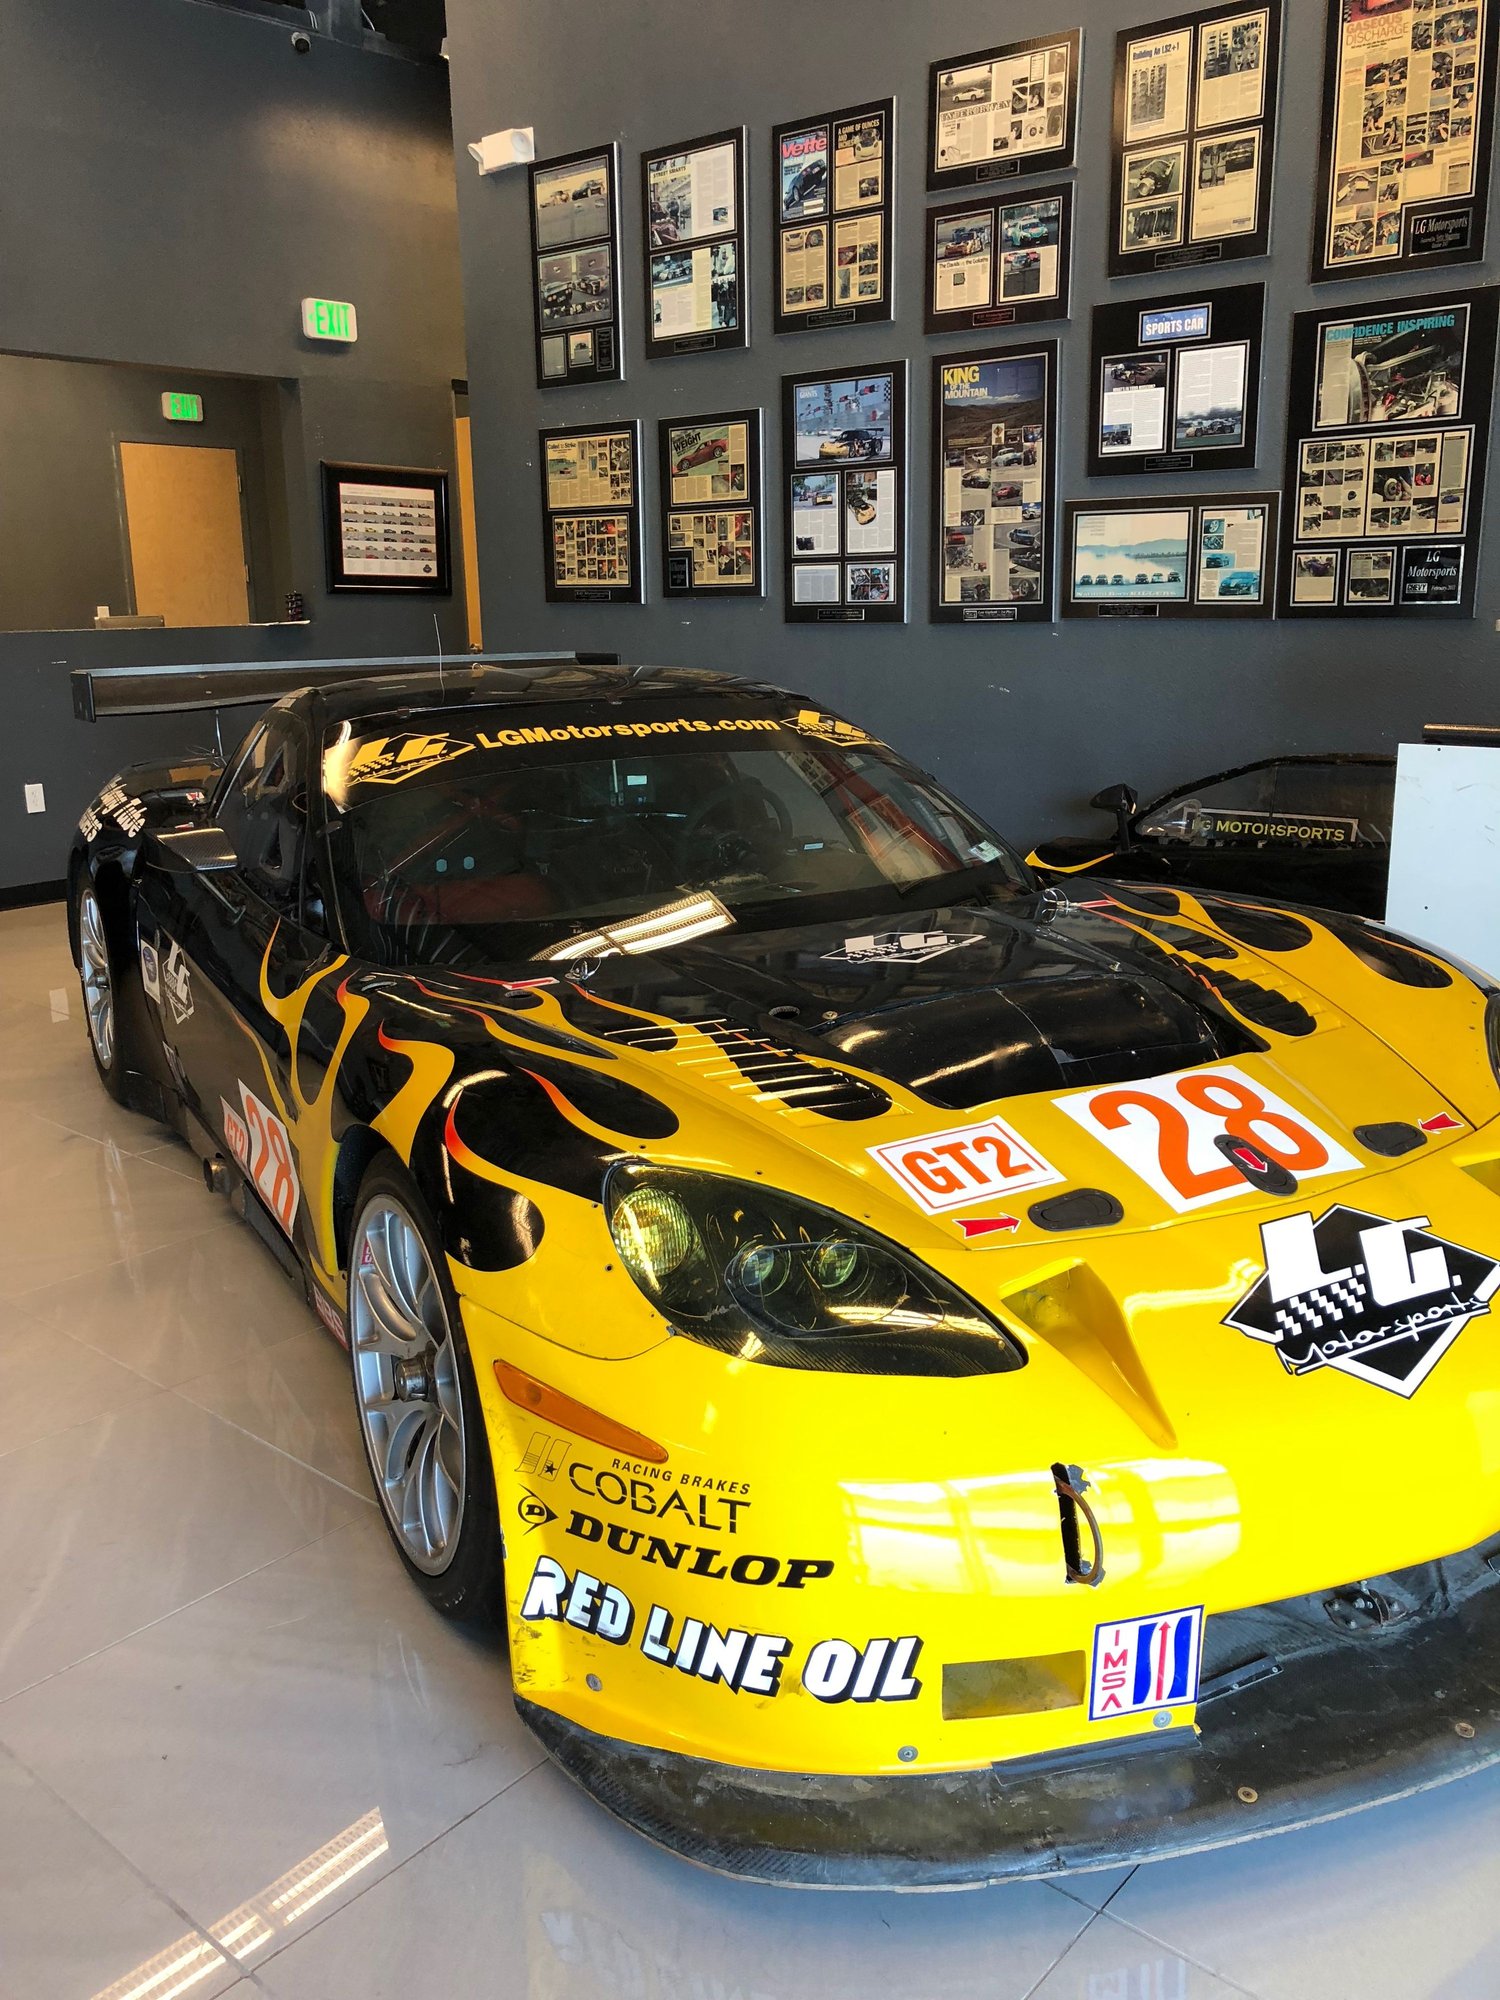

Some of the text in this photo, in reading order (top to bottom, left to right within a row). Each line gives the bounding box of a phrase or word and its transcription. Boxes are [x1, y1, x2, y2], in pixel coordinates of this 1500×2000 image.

[1346, 22, 1409, 46] DISCHARGE
[1347, 14, 1402, 33] GASEOUS
[782, 137, 827, 160] Vette
[1415, 216, 1468, 234] LG Motorsports
[315, 301, 350, 337] EXIT
[1145, 319, 1182, 336] SPORTS
[1185, 317, 1204, 331] CAR
[1326, 322, 1394, 341] CONFIDENCE
[1397, 315, 1455, 332] INSPIRING
[944, 366, 980, 385] KING
[170, 393, 198, 420] EXIT
[945, 387, 988, 399] MOUNTAIN
[672, 432, 701, 452] WEIGHT
[1426, 550, 1441, 563] LG
[1407, 566, 1458, 580] Motorsports
[476, 718, 782, 749] LGMotorsports.com
[113, 797, 147, 838] Tube
[1216, 820, 1346, 841] MOTORSPORTS
[1089, 1074, 1329, 1200] 28
[246, 1094, 295, 1237] 28
[901, 1135, 1035, 1195] GT2
[1277, 1292, 1492, 1375] Motorsports
[612, 1458, 751, 1496] RACING BRAKES
[568, 1461, 752, 1534] COBALT
[565, 1509, 835, 1589] DUNLOP
[520, 1555, 924, 1704] RED LINE OIL
[1101, 1629, 1129, 1712] IMSA
